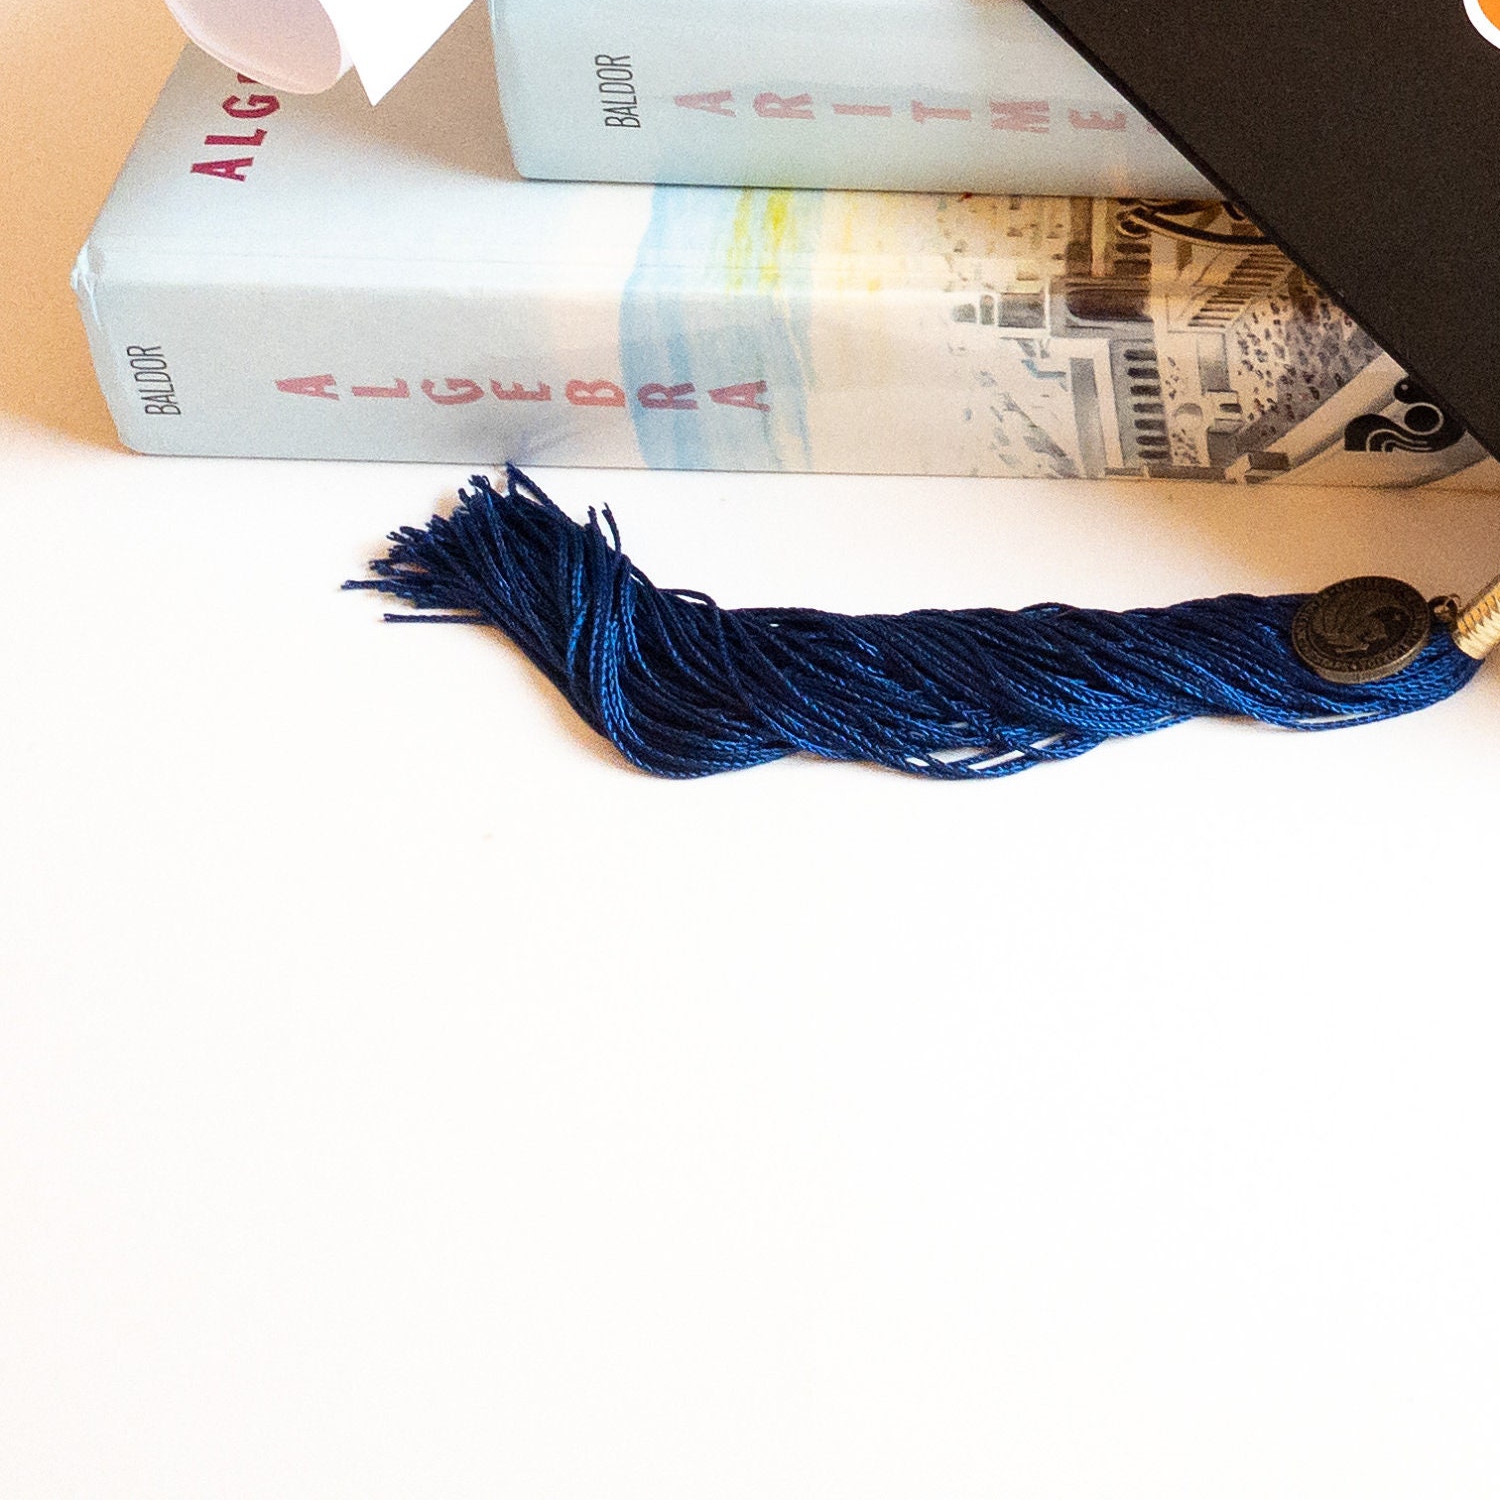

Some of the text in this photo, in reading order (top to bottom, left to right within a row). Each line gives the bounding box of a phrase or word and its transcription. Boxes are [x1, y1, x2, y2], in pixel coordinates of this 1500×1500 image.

[596, 54, 641, 129] BALDOR
[674, 90, 1158, 134] ARITME
[190, 73, 281, 182] ALG
[126, 345, 182, 416] BALDOR
[275, 374, 771, 412] ALGEBRA
